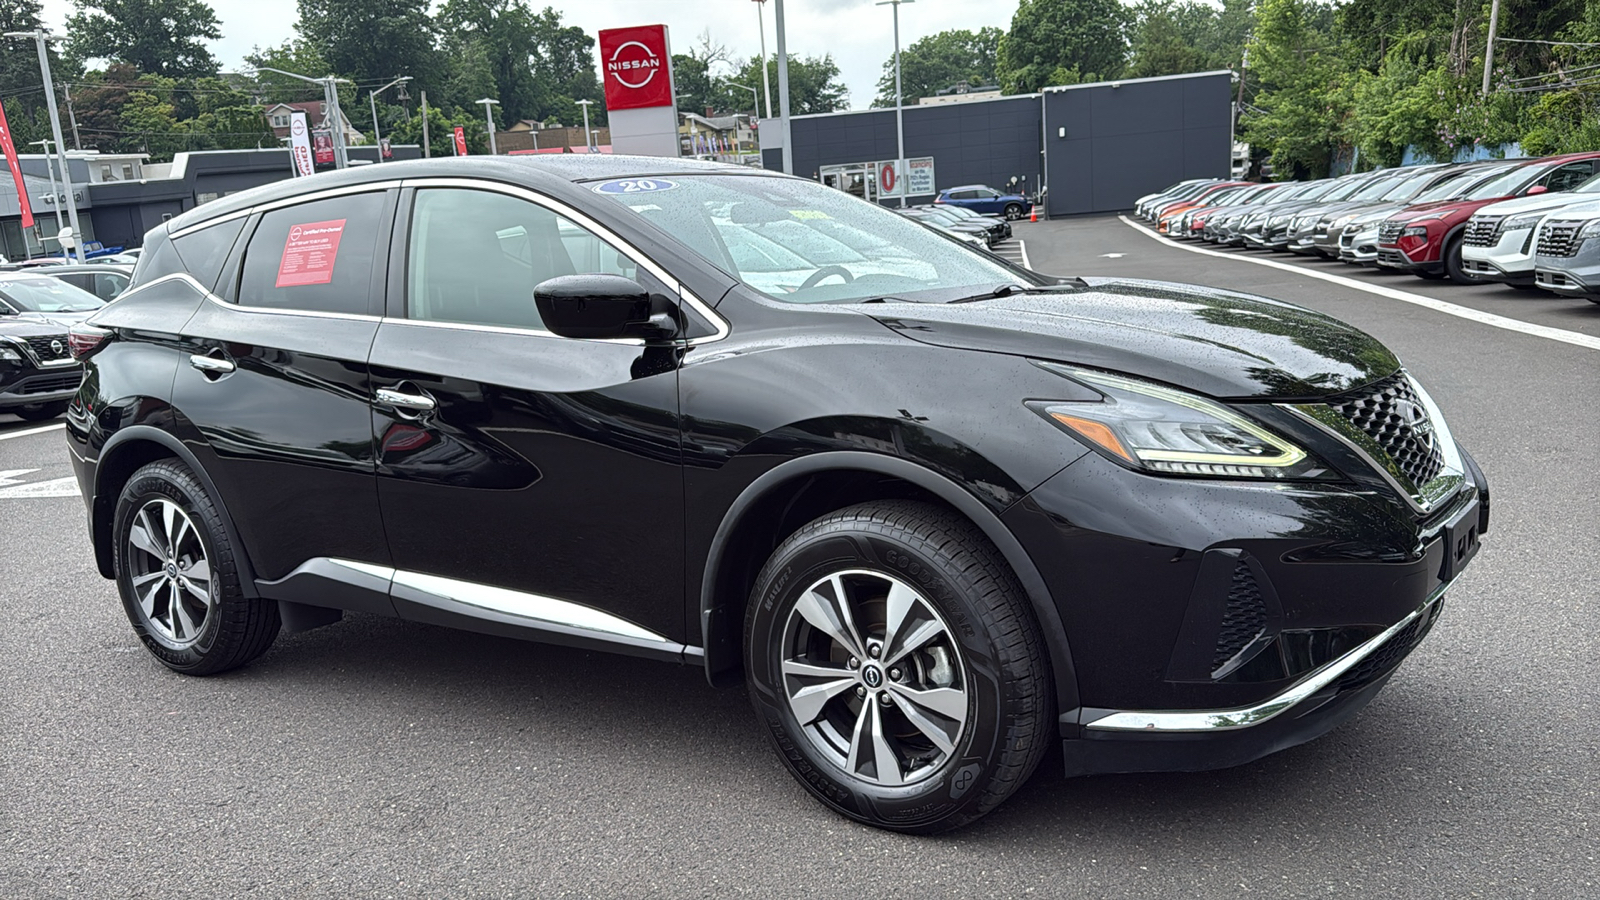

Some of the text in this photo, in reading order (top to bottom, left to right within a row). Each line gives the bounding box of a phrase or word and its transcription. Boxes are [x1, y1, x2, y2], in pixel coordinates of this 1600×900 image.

[608, 58, 660, 71] NISSAN
[619, 180, 658, 192] 20
[886, 549, 976, 638] GOODYEAR
